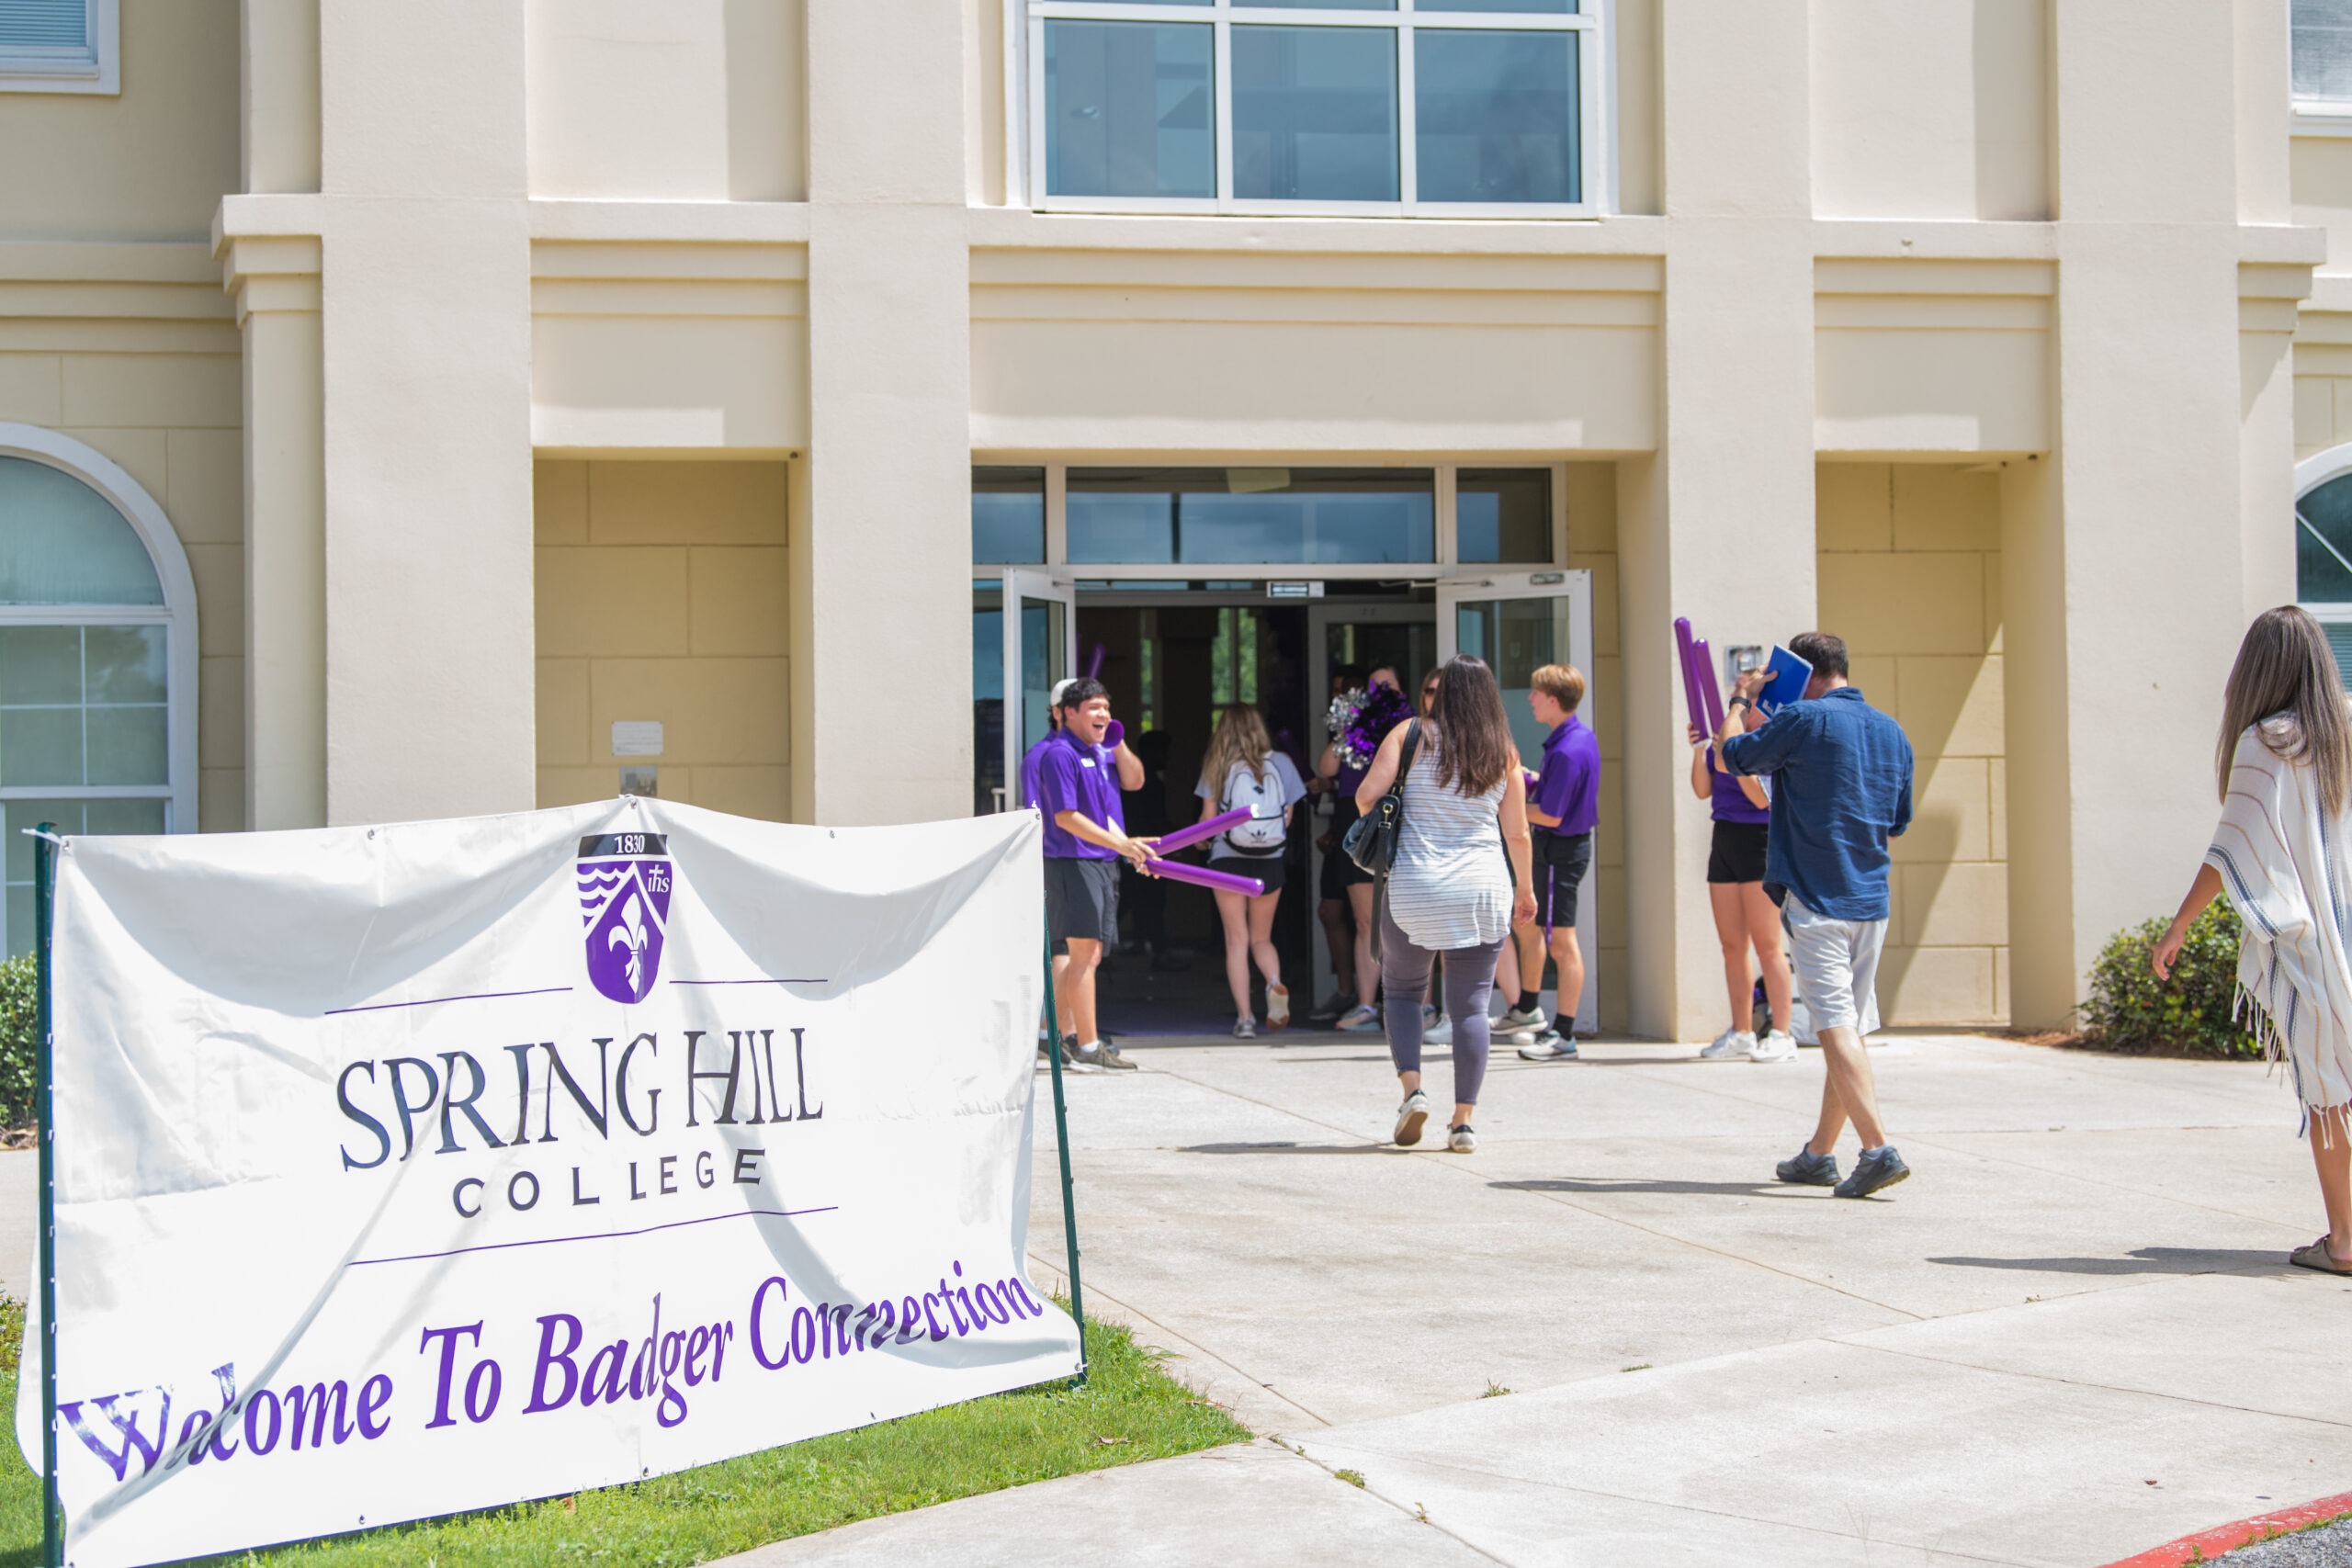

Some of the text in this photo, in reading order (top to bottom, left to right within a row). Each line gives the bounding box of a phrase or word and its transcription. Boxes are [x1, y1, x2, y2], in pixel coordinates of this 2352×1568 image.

[614, 834, 645, 853] 1830
[337, 1028, 823, 1172] SPRING HILL
[453, 1148, 766, 1219] COLLEGE
[58, 1259, 1043, 1482] Welcome To Badger Connection
